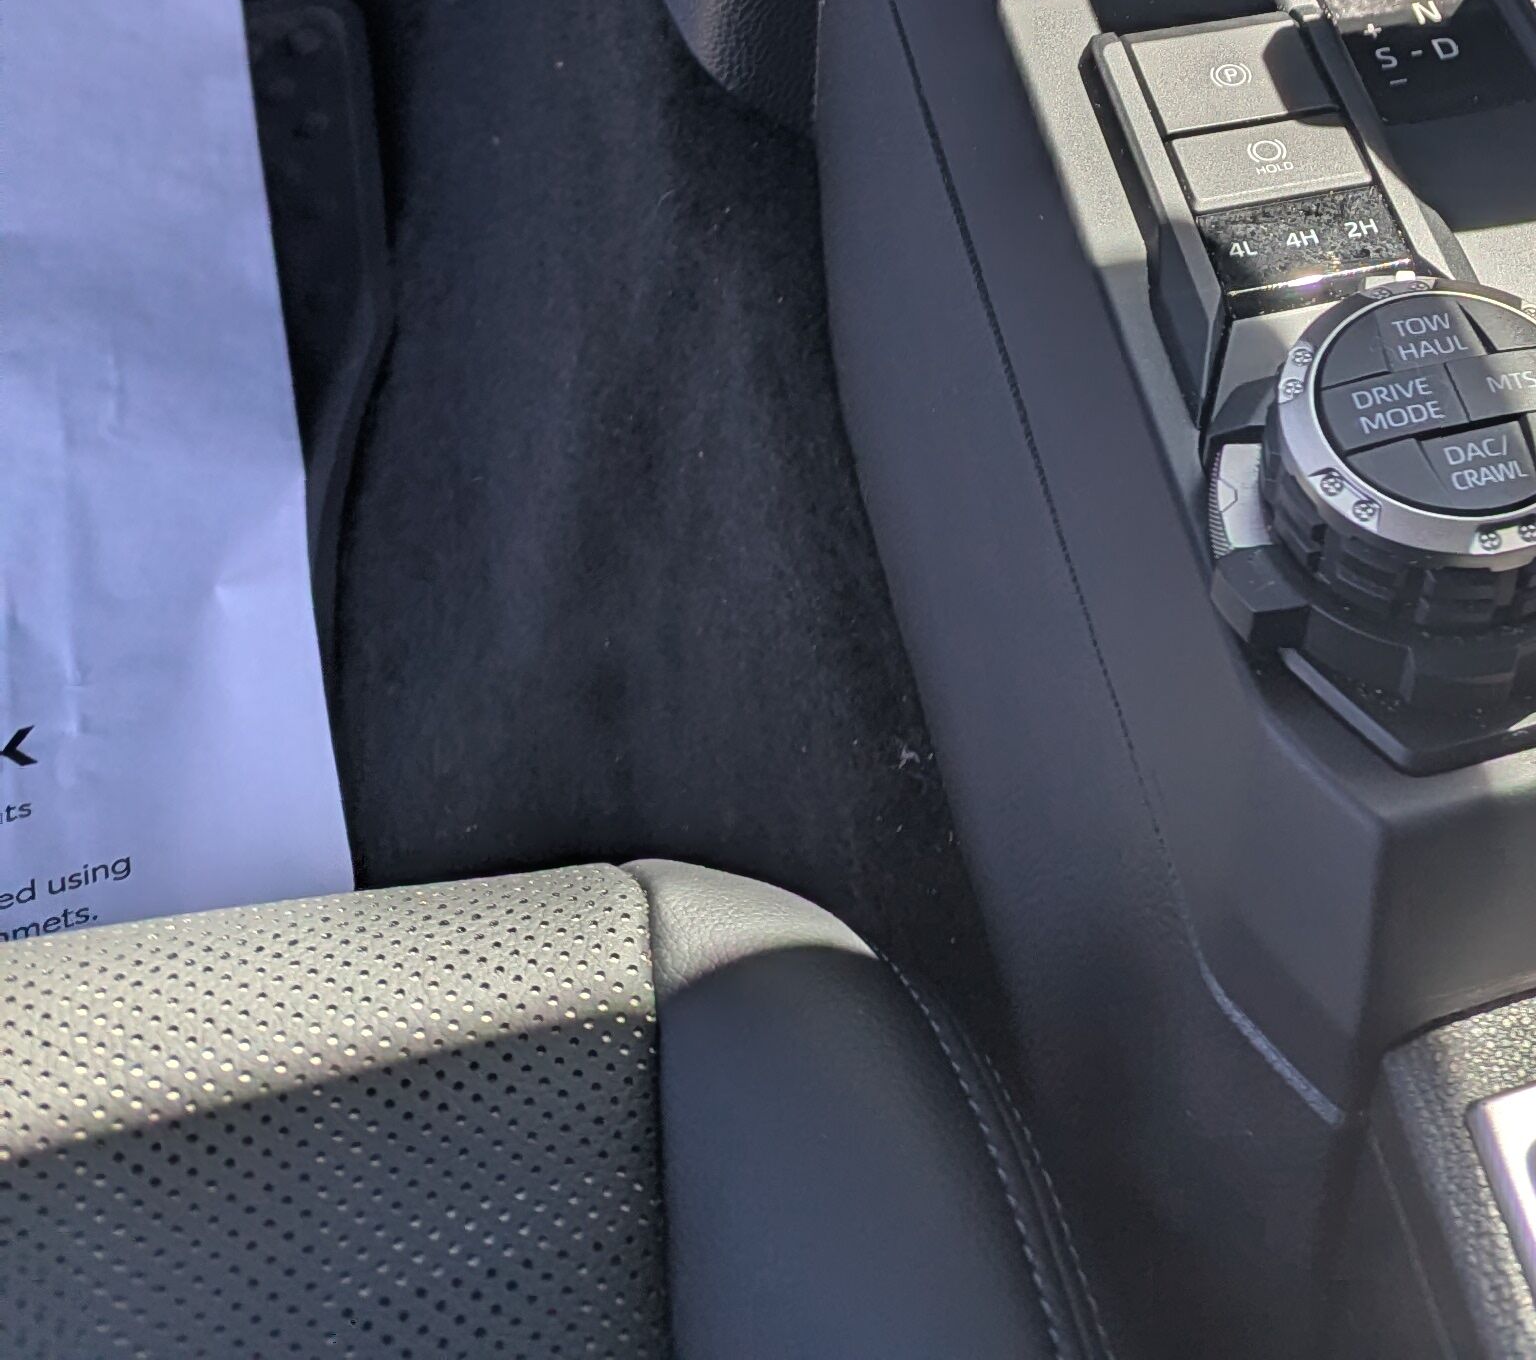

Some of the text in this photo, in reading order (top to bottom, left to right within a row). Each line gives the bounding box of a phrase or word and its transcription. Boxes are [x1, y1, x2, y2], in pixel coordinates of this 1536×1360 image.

[1411, 0, 1442, 25] N
[1255, 161, 1294, 175] HOLD
[1229, 218, 1379, 259] 4L 4H 2H
[1392, 312, 1451, 337] TOW
[1398, 334, 1468, 361] HAUL
[1351, 376, 1433, 410] DRIVE
[1359, 399, 1446, 434] MODE
[1443, 434, 1509, 466] DAC/
[1451, 459, 1529, 491] CRAWL
[0, 856, 131, 910] ed using
